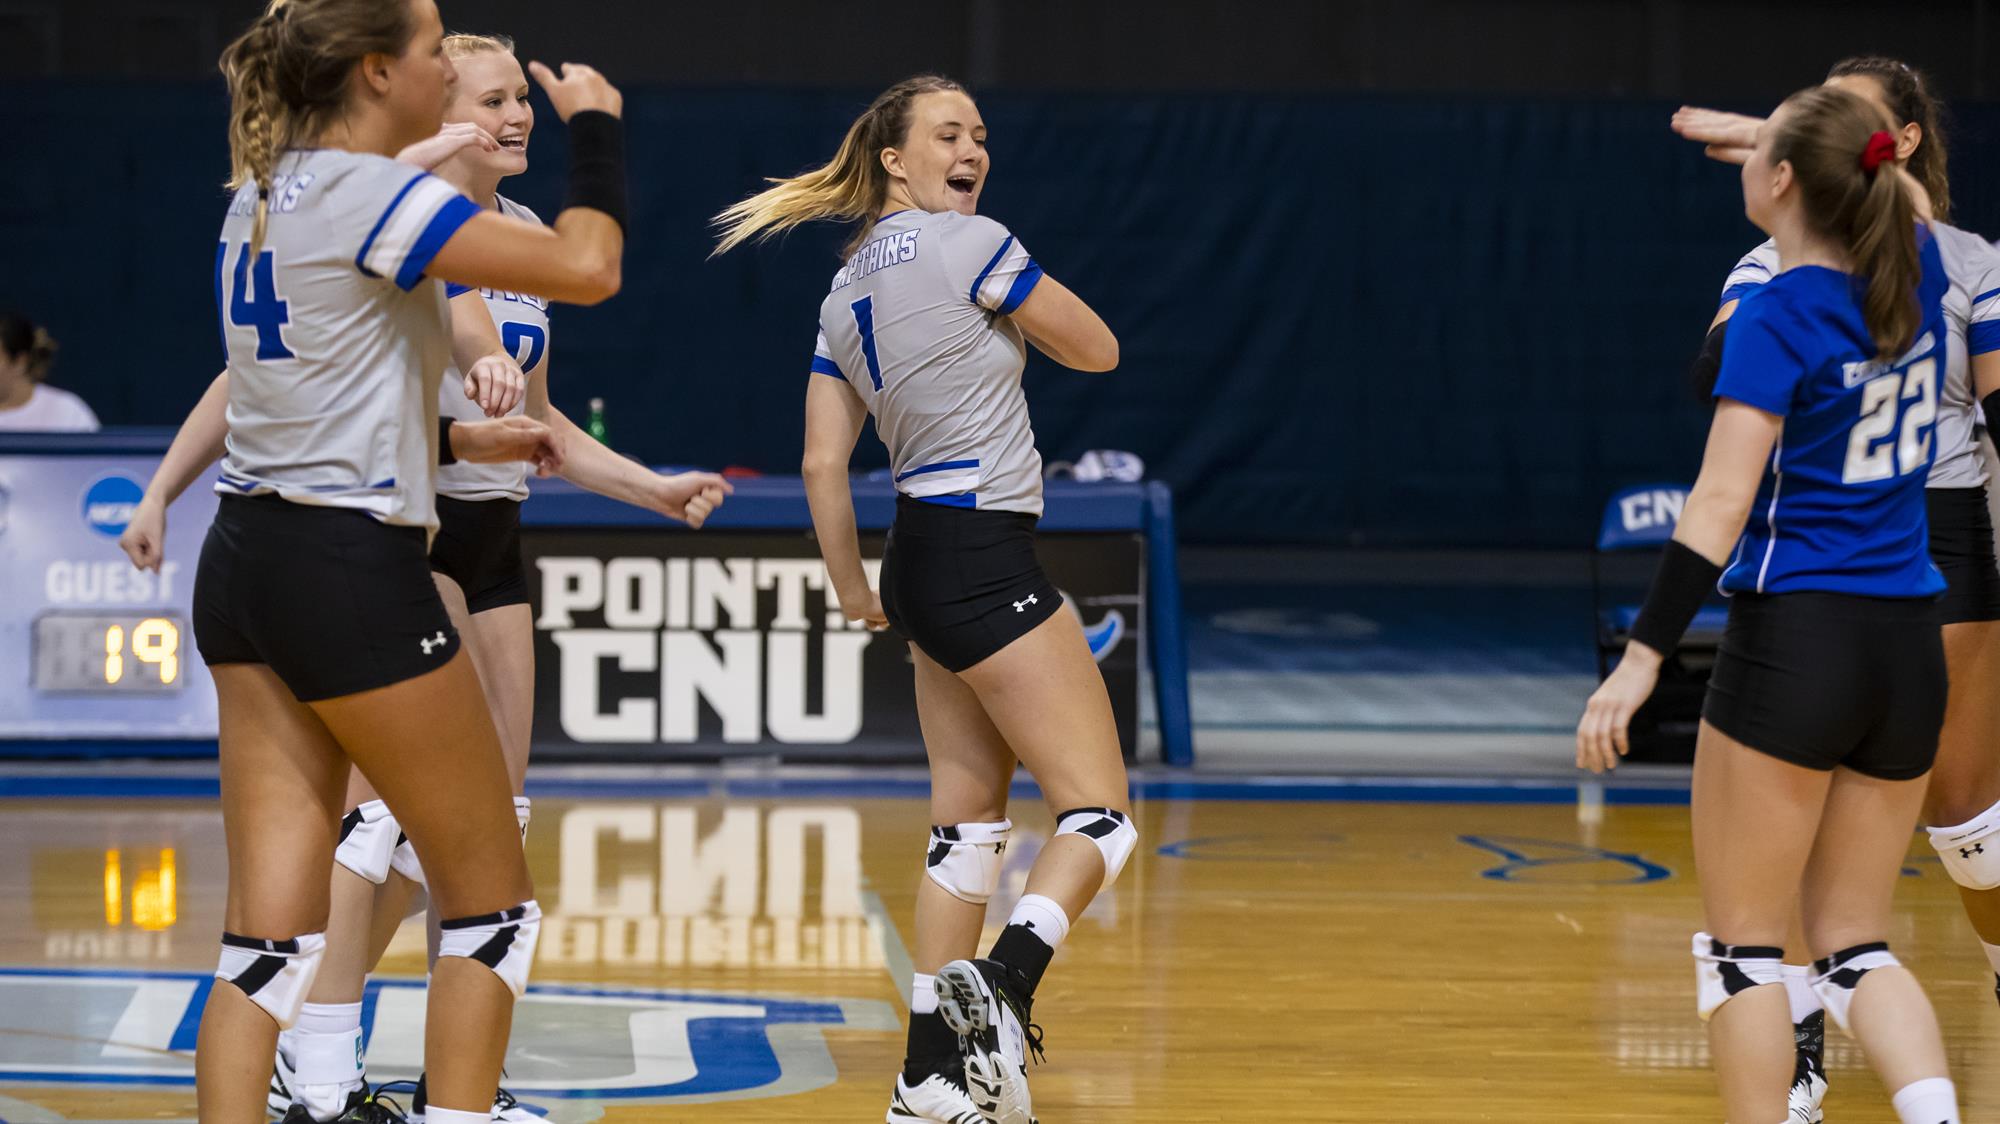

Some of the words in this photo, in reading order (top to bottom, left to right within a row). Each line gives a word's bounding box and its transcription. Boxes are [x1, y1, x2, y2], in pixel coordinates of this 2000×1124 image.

[851, 292, 885, 392] 1
[1842, 357, 1937, 484] 22
[1619, 490, 1685, 531] CN
[45, 559, 181, 602] GUEST
[105, 617, 178, 684] 19
[551, 630, 873, 744] CNU
